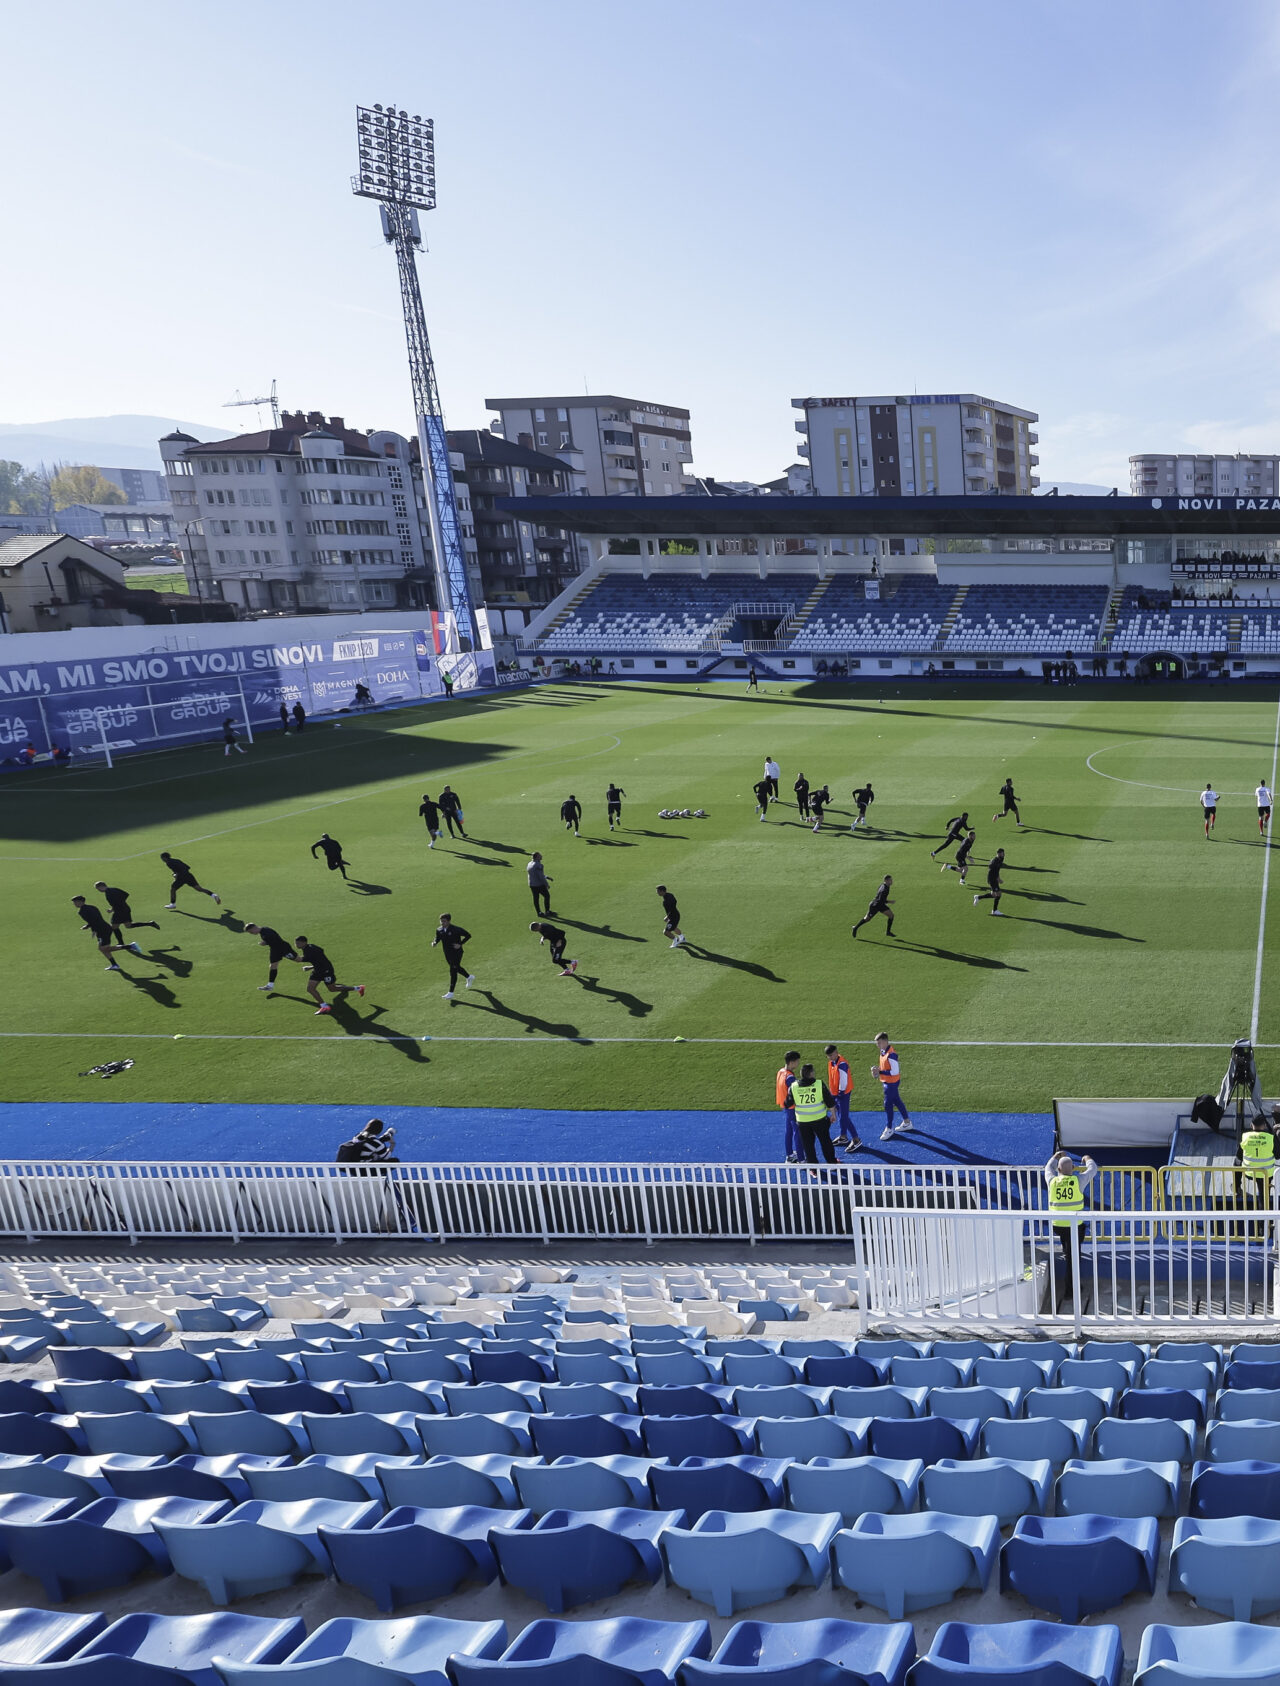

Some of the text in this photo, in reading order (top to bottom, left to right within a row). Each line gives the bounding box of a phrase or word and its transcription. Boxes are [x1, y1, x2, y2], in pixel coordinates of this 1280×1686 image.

[821, 397, 857, 407] SAFETY
[1178, 498, 1222, 510] NOVI
[339, 643, 357, 659] FKNP
[57, 664, 96, 688] MI
[103, 658, 168, 684] SMO
[174, 651, 247, 676] TVOJI
[251, 644, 324, 668] SINOVI
[327, 677, 363, 690] MAGNUS
[377, 670, 410, 685] DOHA
[498, 670, 531, 684] macron
[274, 685, 299, 695] DOHA
[275, 691, 302, 702] INVEST
[78, 703, 137, 721] DOHA
[170, 702, 231, 720] GROUP
[66, 714, 138, 735] GROUP
[799, 1093, 816, 1104] 726
[1055, 1187, 1074, 1200] 549
